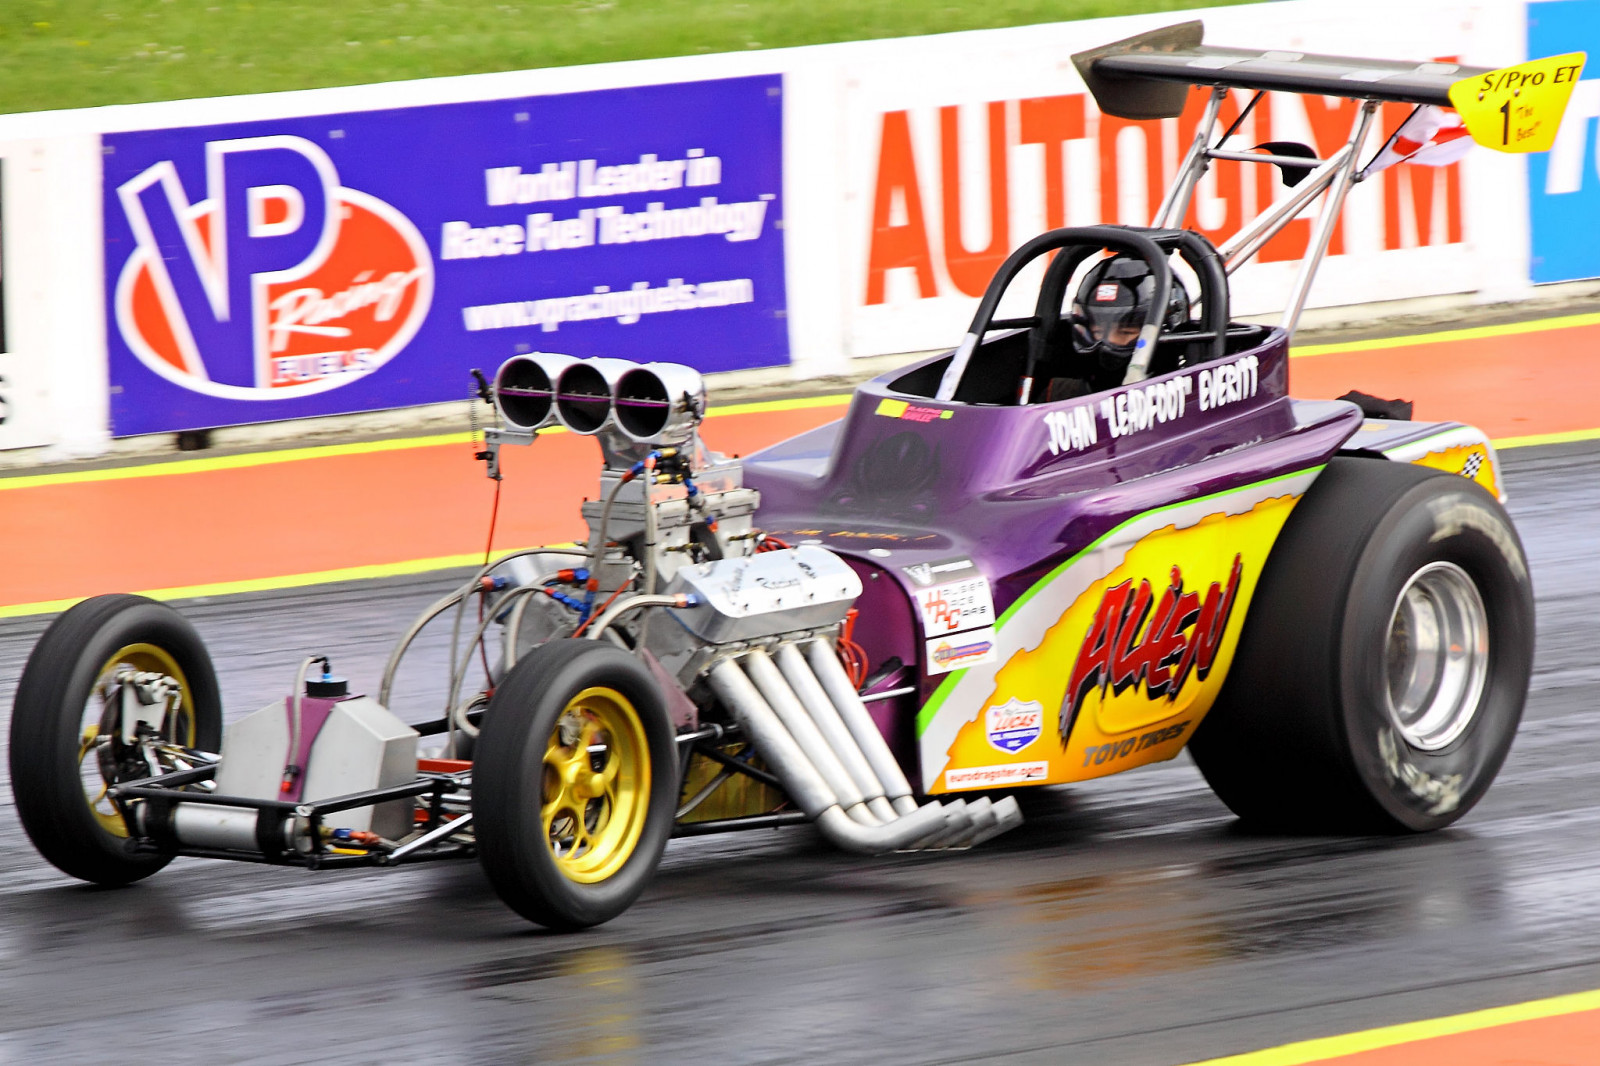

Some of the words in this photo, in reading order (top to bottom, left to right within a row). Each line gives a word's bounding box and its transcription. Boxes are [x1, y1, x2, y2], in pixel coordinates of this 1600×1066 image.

[1480, 71, 1545, 92] S/Pro
[1553, 65, 1580, 84] ET
[1499, 99, 1510, 147] 1
[485, 161, 577, 206] World
[577, 153, 686, 198] Leader
[685, 147, 722, 187] in
[441, 221, 526, 260] Race
[526, 208, 597, 252] Fuel
[116, 134, 342, 392] VP
[269, 270, 428, 353] Racing
[271, 348, 381, 383] FUELS
[1043, 403, 1098, 456] JOHN
[1199, 355, 1259, 412] EVERITT
[1083, 736, 1137, 767] TOYO
